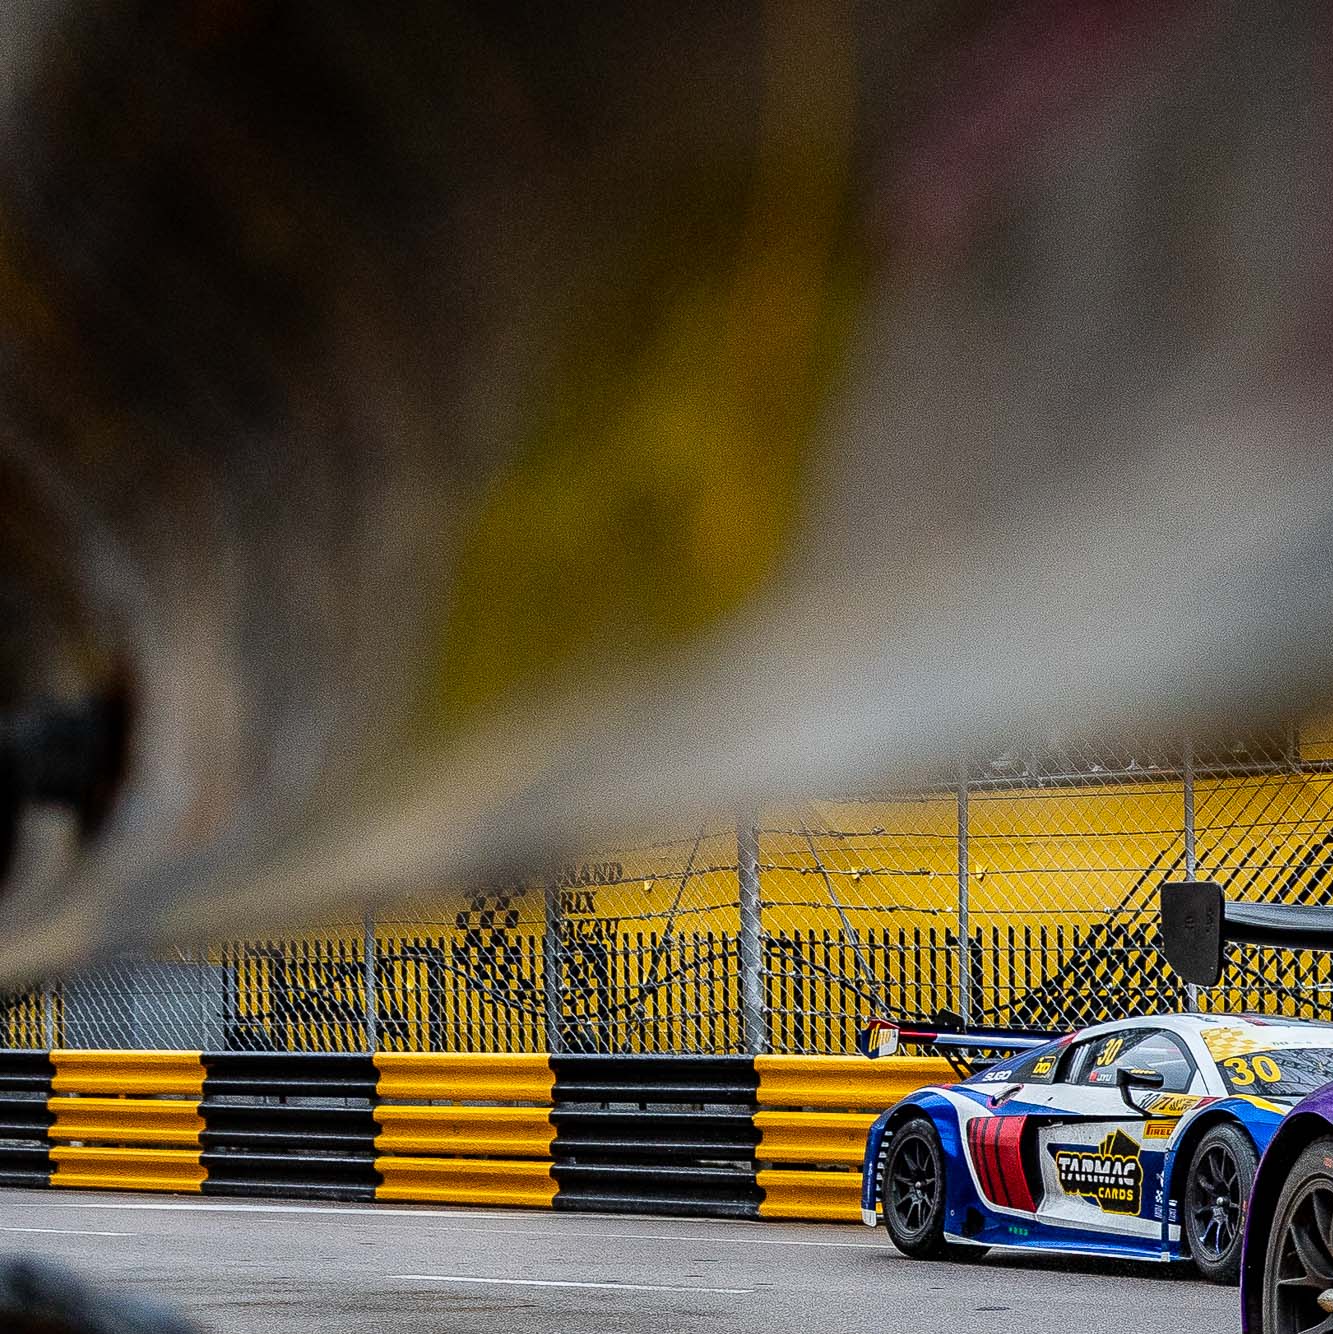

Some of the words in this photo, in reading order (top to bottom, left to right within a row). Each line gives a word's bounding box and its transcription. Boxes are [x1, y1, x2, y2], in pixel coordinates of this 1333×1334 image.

[560, 890, 597, 914] RIX
[1097, 1039, 1123, 1066] 30
[1223, 1056, 1281, 1085] 30
[1151, 1097, 1175, 1111] 71
[1146, 1124, 1176, 1136] PIREL
[1058, 1157, 1137, 1186] TARMAC
[1098, 1187, 1134, 1200] CARDS
